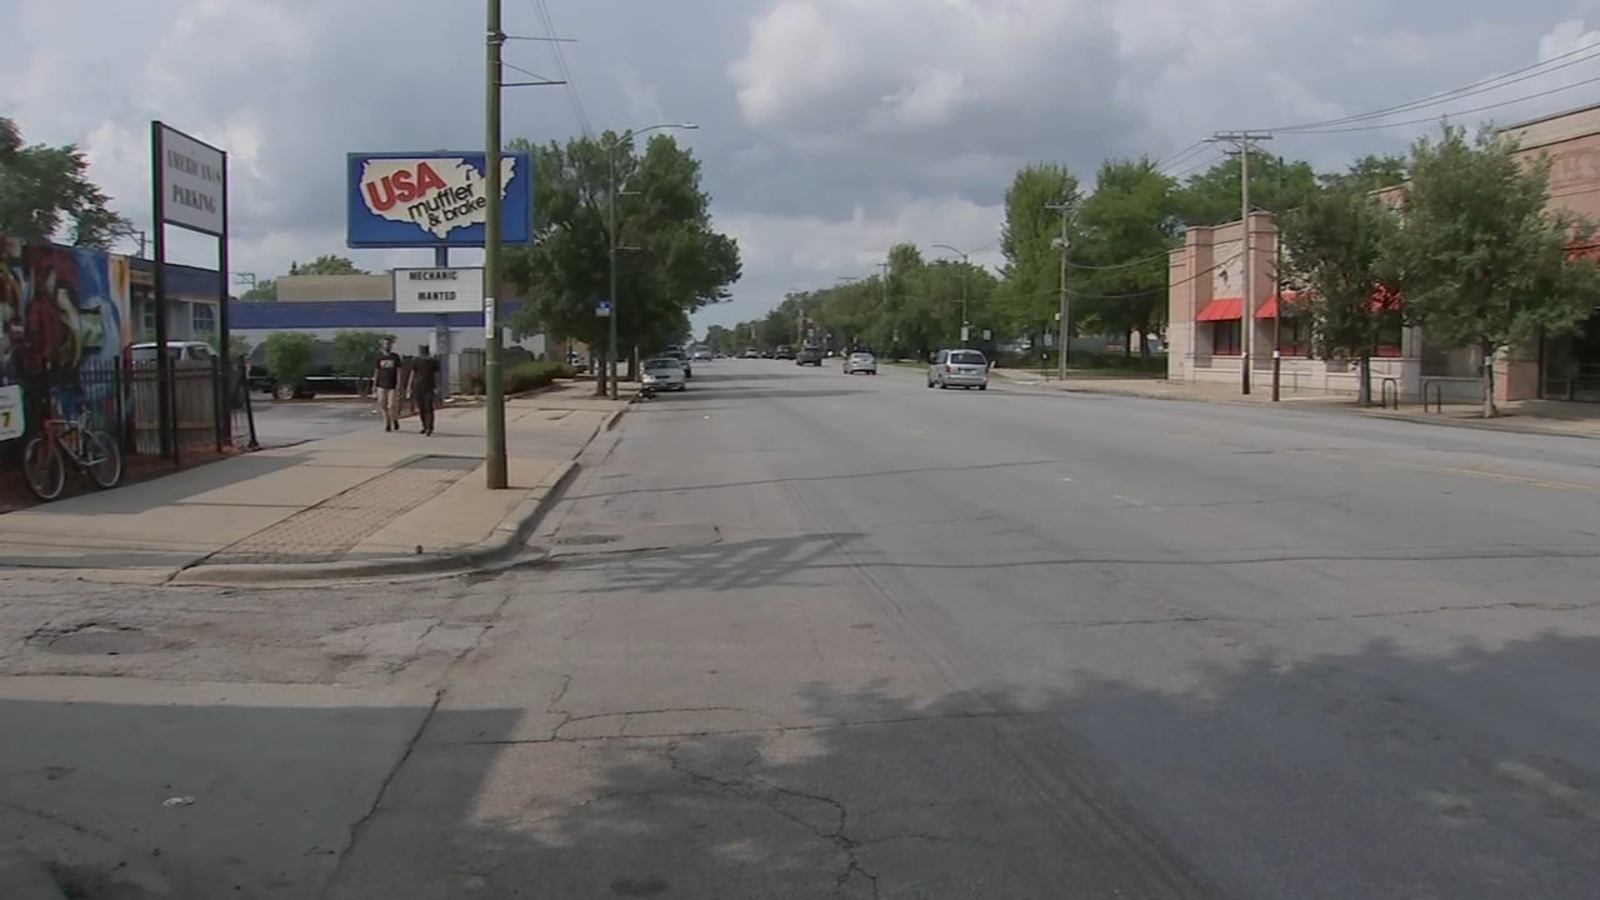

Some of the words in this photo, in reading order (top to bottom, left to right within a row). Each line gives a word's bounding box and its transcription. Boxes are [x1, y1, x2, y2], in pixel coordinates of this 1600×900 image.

[366, 161, 447, 212] USA
[172, 184, 216, 214] PARKING
[407, 183, 474, 220] muffler
[428, 213, 442, 227] &
[409, 271, 458, 281] MECHANIC
[418, 291, 457, 301] WANTED
